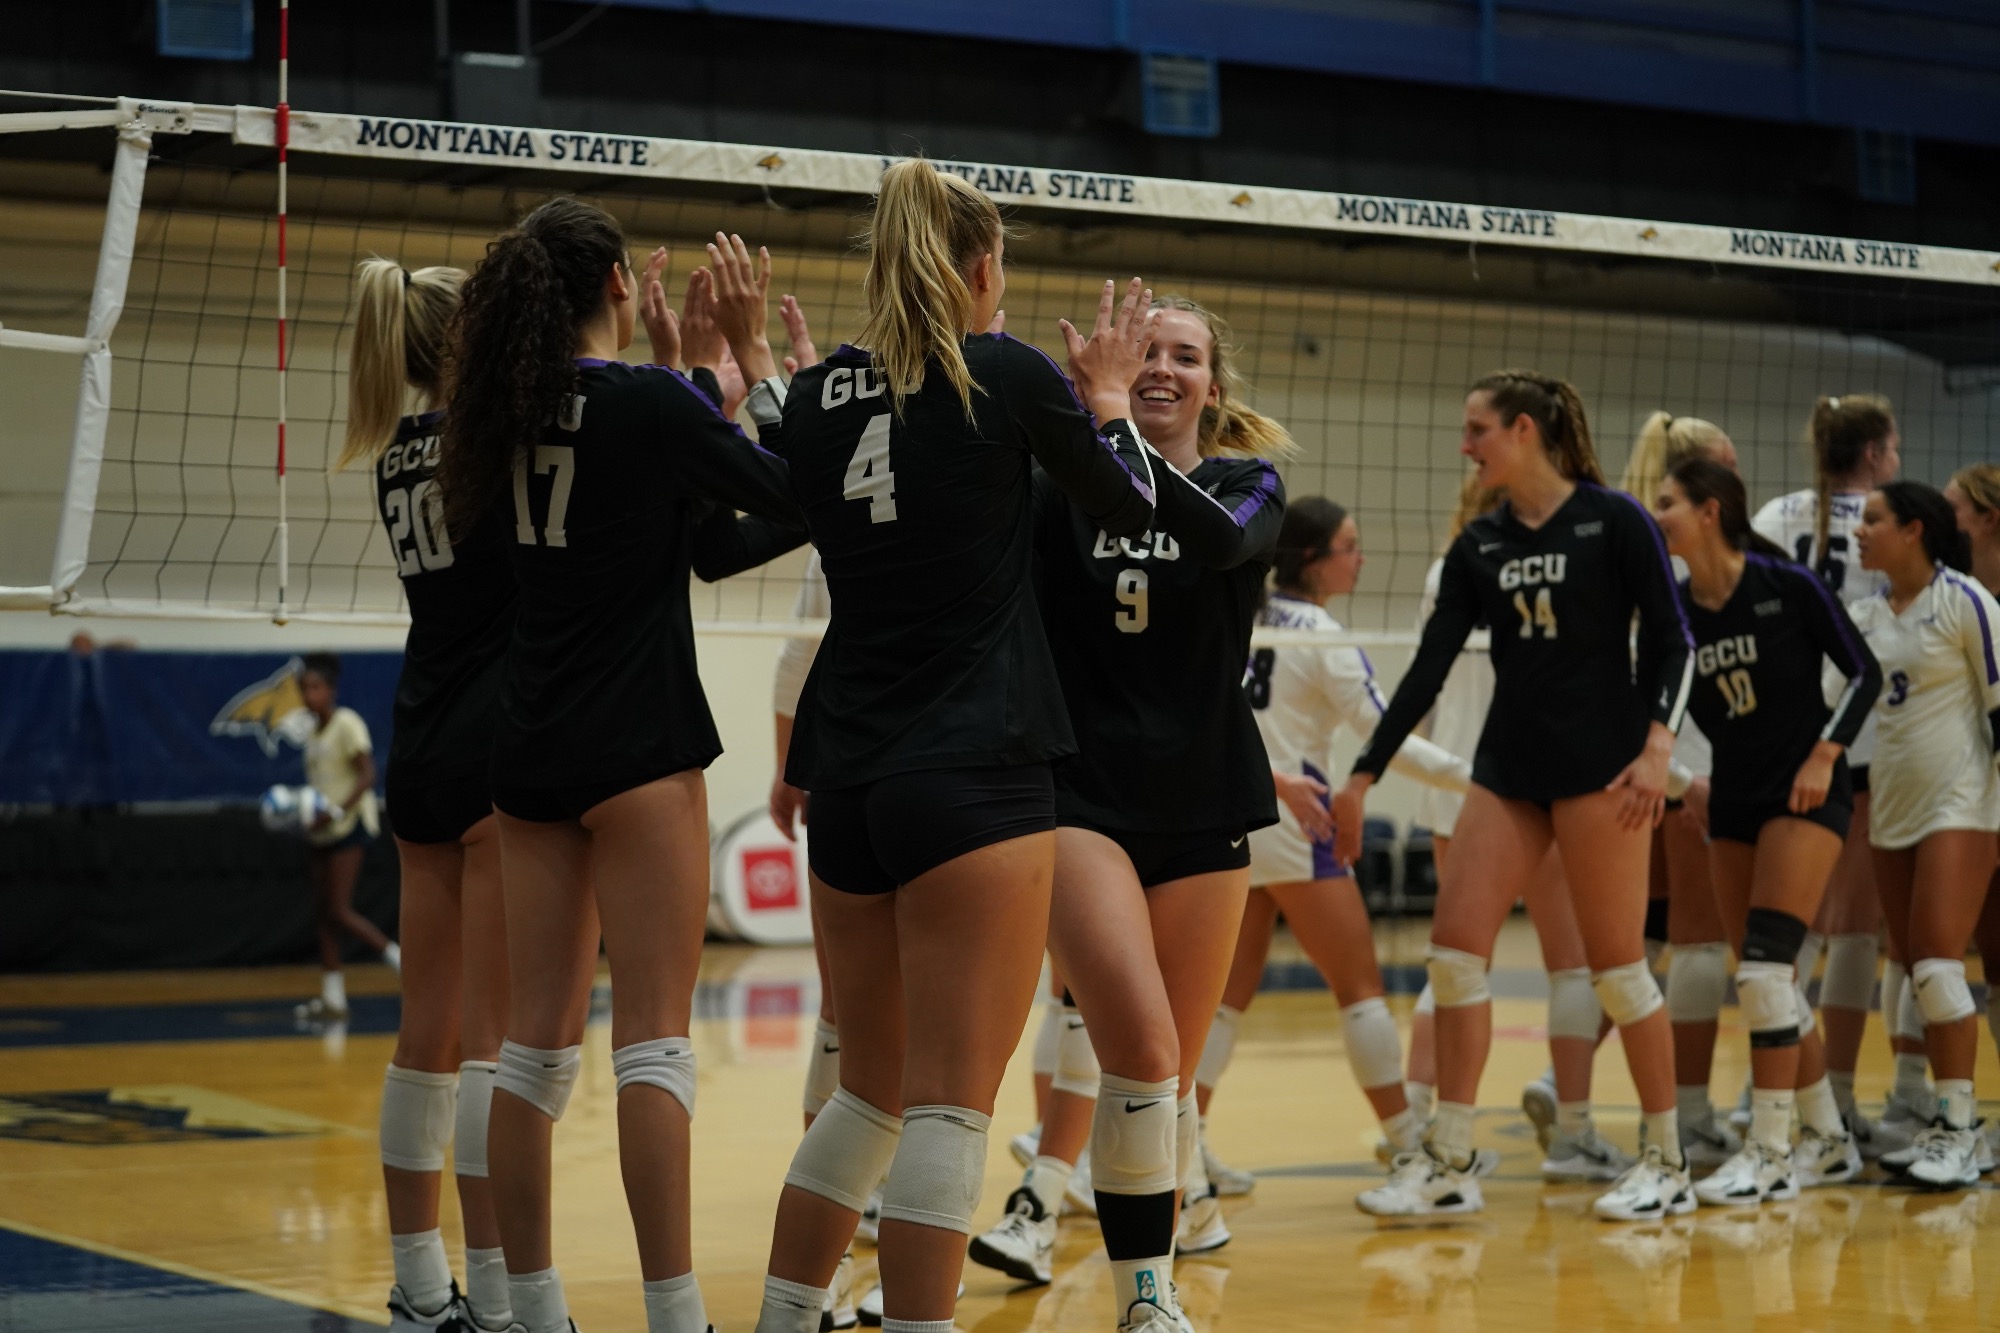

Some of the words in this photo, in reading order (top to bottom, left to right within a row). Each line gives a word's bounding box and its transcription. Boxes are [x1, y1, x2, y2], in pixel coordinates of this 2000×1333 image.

[356, 119, 535, 158] MONTANA
[550, 134, 648, 166] STATE
[882, 158, 1035, 196] TANA
[1048, 173, 1136, 203] STATE
[1337, 198, 1471, 231] MONTANA
[1481, 208, 1556, 237] STATE
[1731, 232, 1846, 263] MONTANA
[1855, 242, 1920, 268] STATE
[382, 434, 443, 480] GCU
[843, 413, 897, 524] 4
[511, 445, 577, 548] 17
[386, 480, 455, 577] 20
[1093, 529, 1180, 562] GCU
[1499, 553, 1567, 591] GCU
[1115, 568, 1149, 634] 9
[1513, 587, 1558, 639] 14
[1697, 634, 1758, 677] GCU
[1716, 668, 1757, 719] 10
